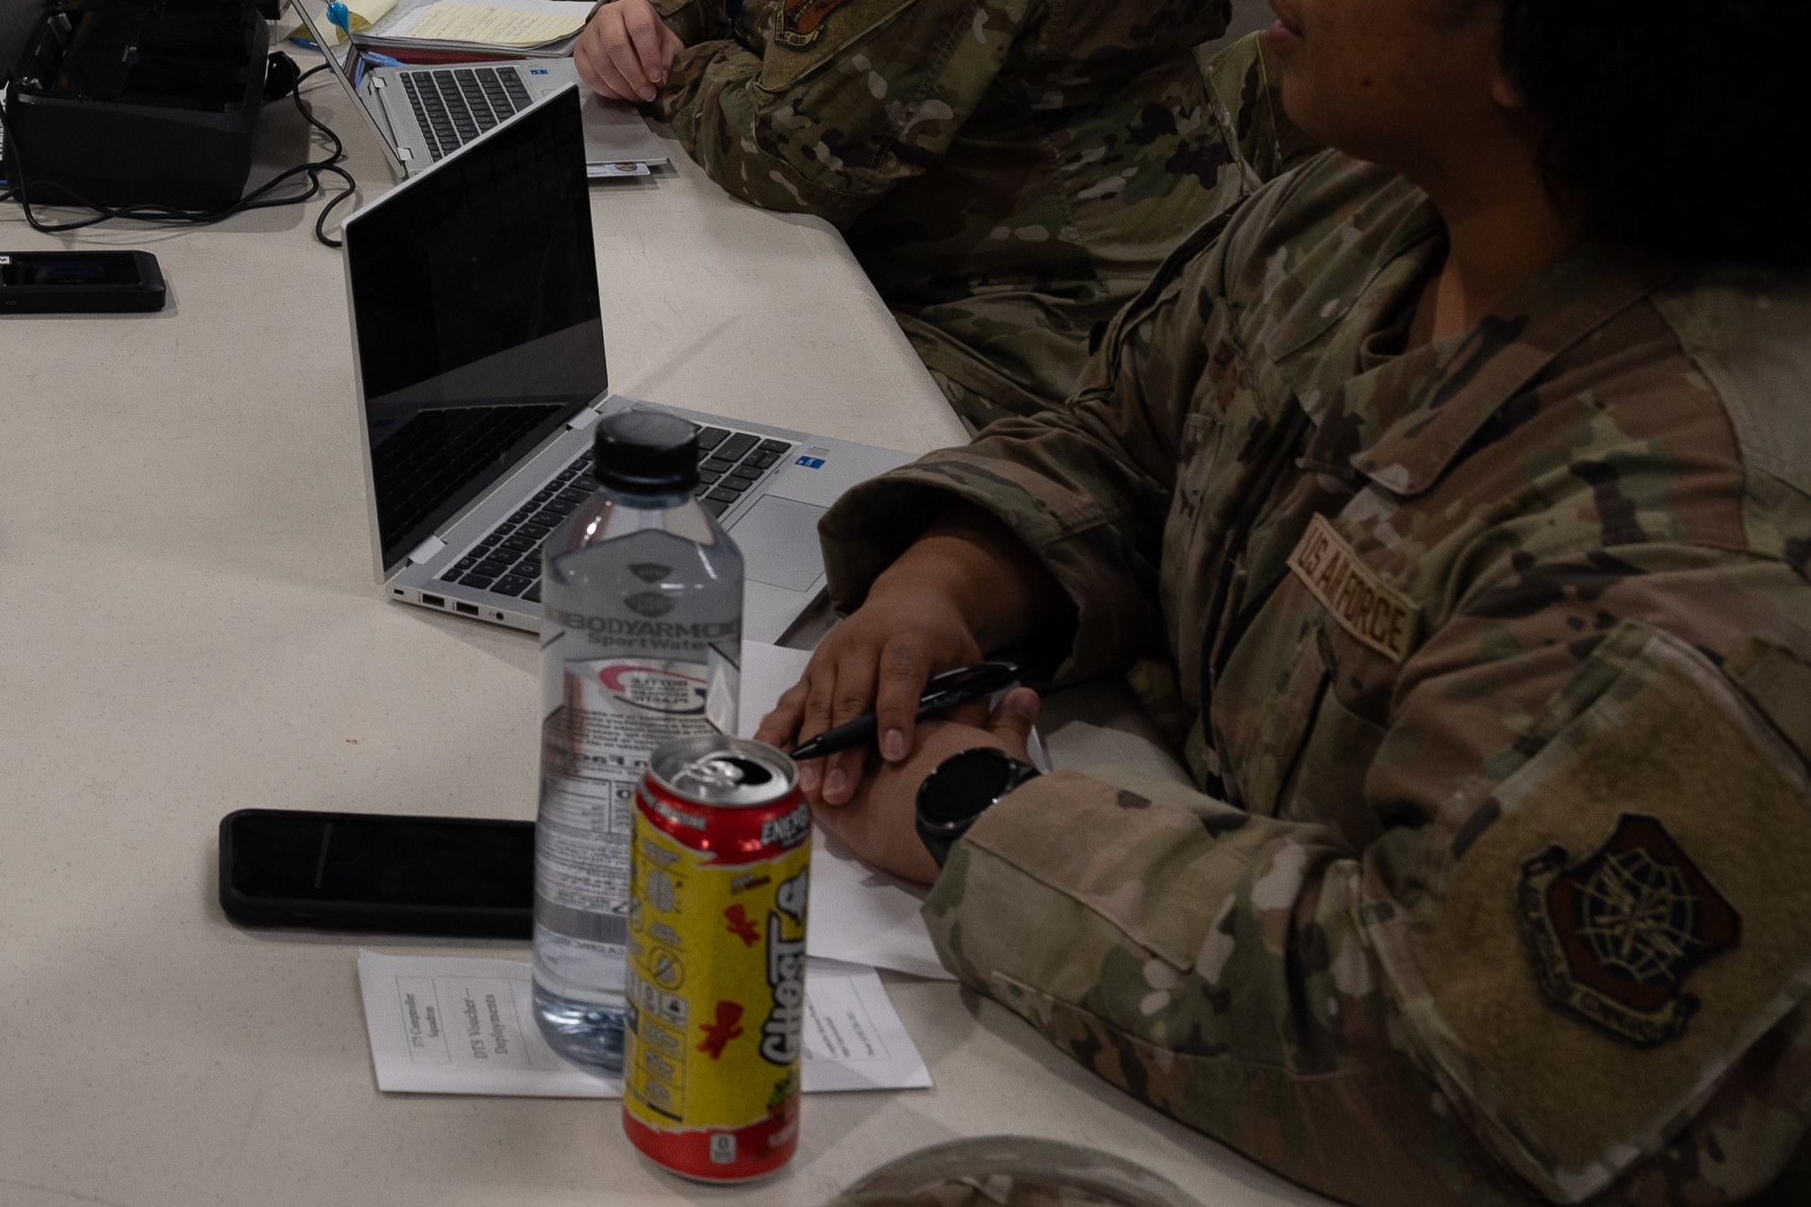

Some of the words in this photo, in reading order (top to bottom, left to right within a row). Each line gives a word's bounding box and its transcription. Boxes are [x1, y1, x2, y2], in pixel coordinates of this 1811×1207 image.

[1315, 550, 1351, 611] AIR
[1336, 571, 1406, 653] FORCE
[758, 909, 808, 1066] GHOST
[425, 1004, 440, 1038] Squadron
[469, 1038, 488, 1059] DTS
[483, 992, 511, 1055] Deployments
